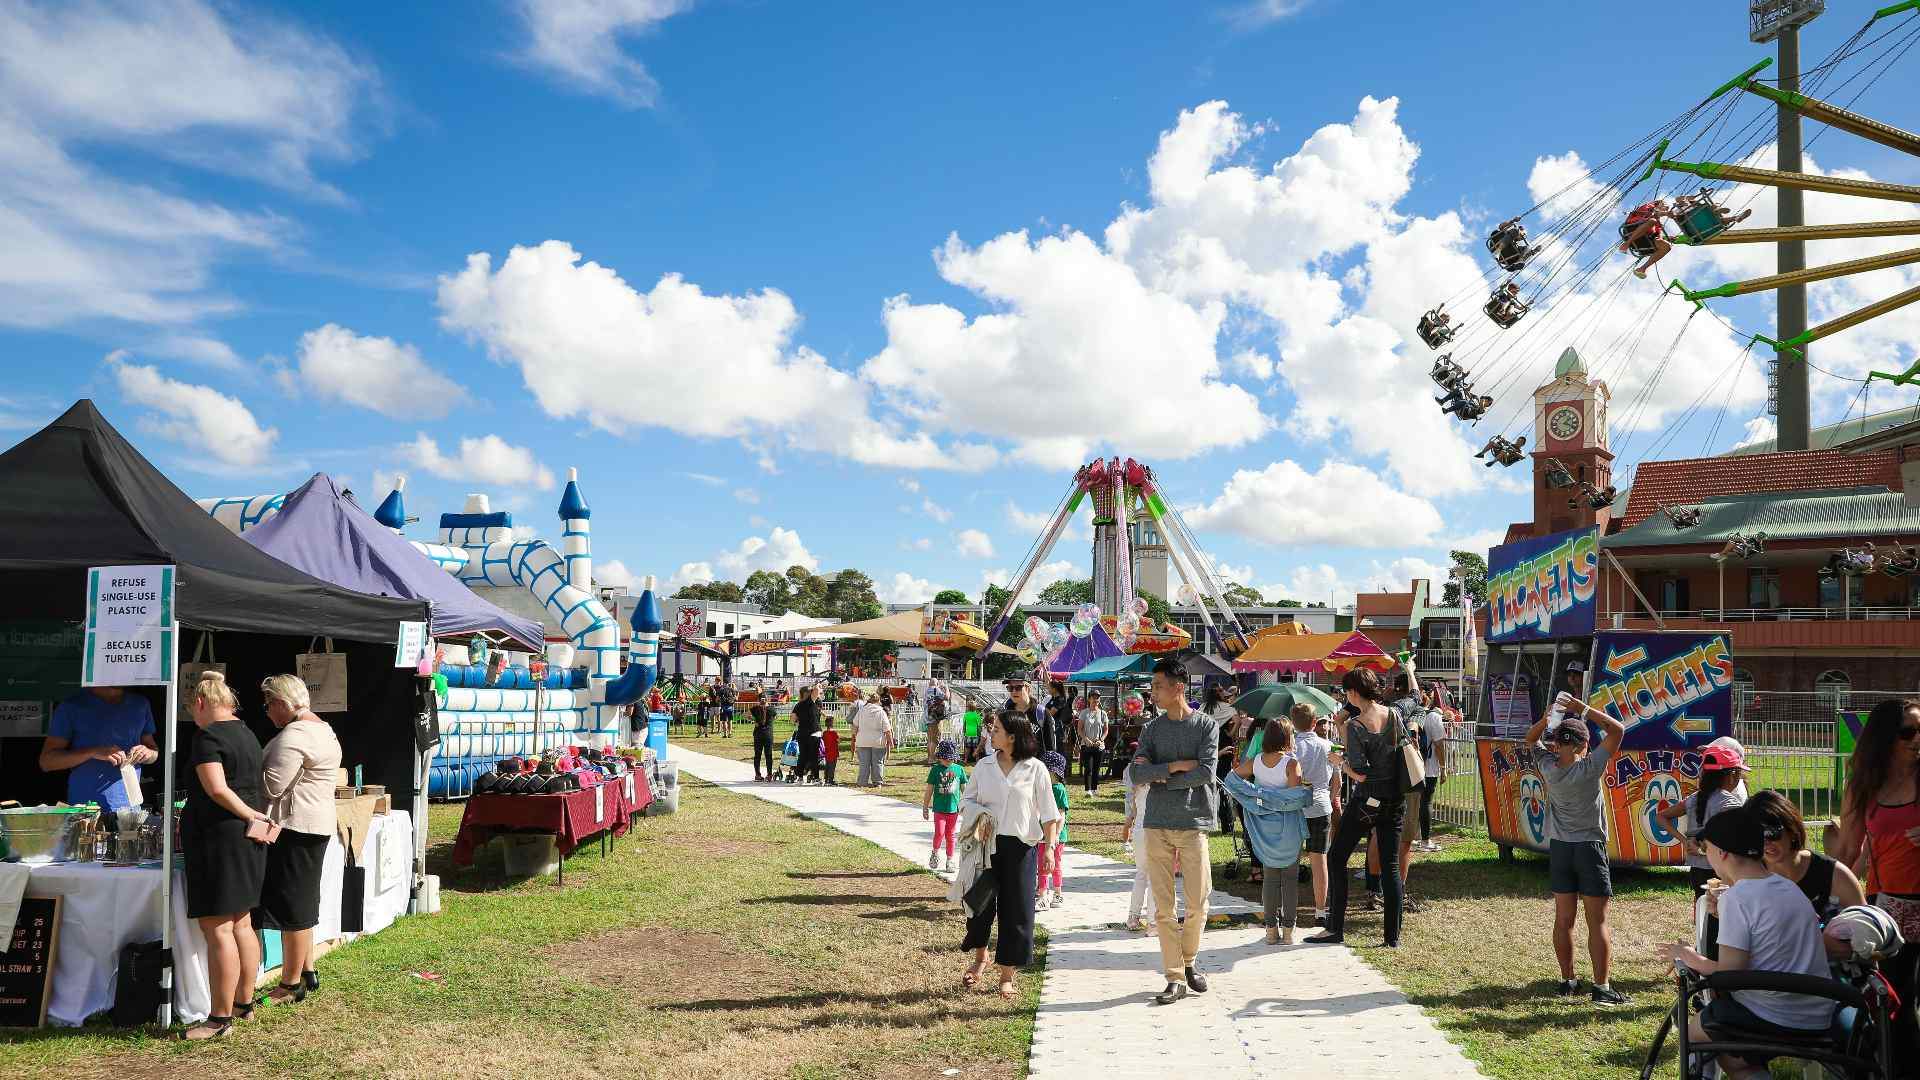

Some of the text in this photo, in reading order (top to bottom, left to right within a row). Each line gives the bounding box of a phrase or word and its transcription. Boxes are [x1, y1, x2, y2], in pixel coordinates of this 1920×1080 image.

[111, 578, 146, 588] REFUSE
[1488, 529, 1597, 636] TICKETS
[101, 592, 156, 602] SINGLE-USE
[107, 606, 147, 615] PLASTIC
[105, 654, 147, 663] TURTLES
[1589, 636, 1731, 735] TICKETS
[8, 964, 32, 973] STRAW
